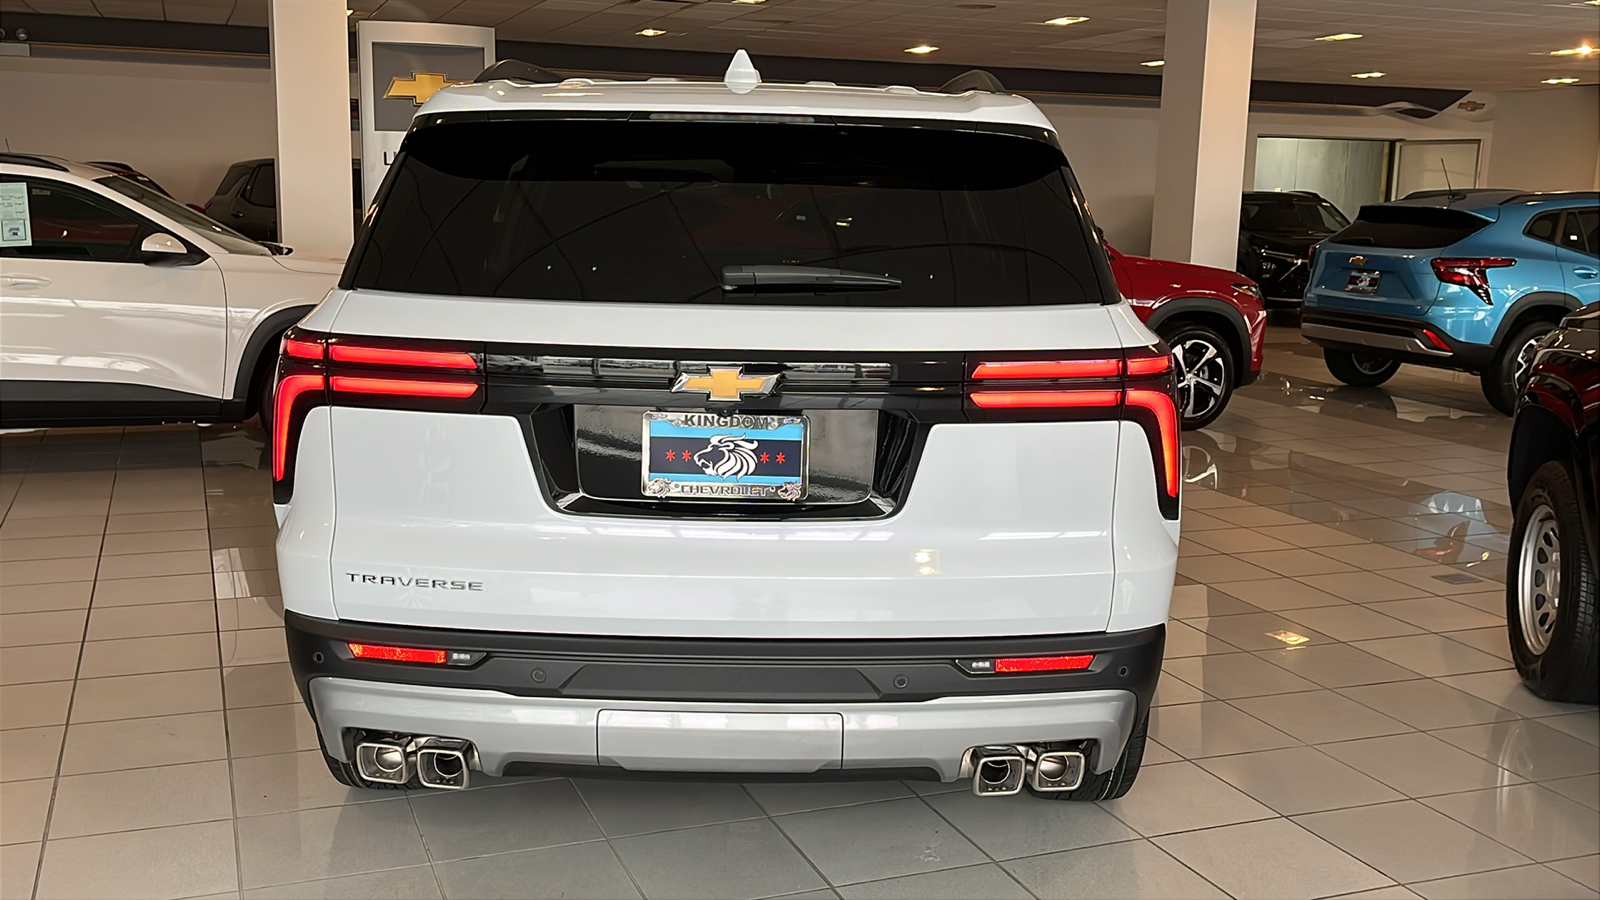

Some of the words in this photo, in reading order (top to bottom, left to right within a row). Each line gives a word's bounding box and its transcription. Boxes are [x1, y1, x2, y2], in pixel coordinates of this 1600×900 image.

[684, 414, 769, 430] KINGDOM
[680, 484, 769, 497] CHEVROLET
[346, 572, 484, 592] TRAVERSE
